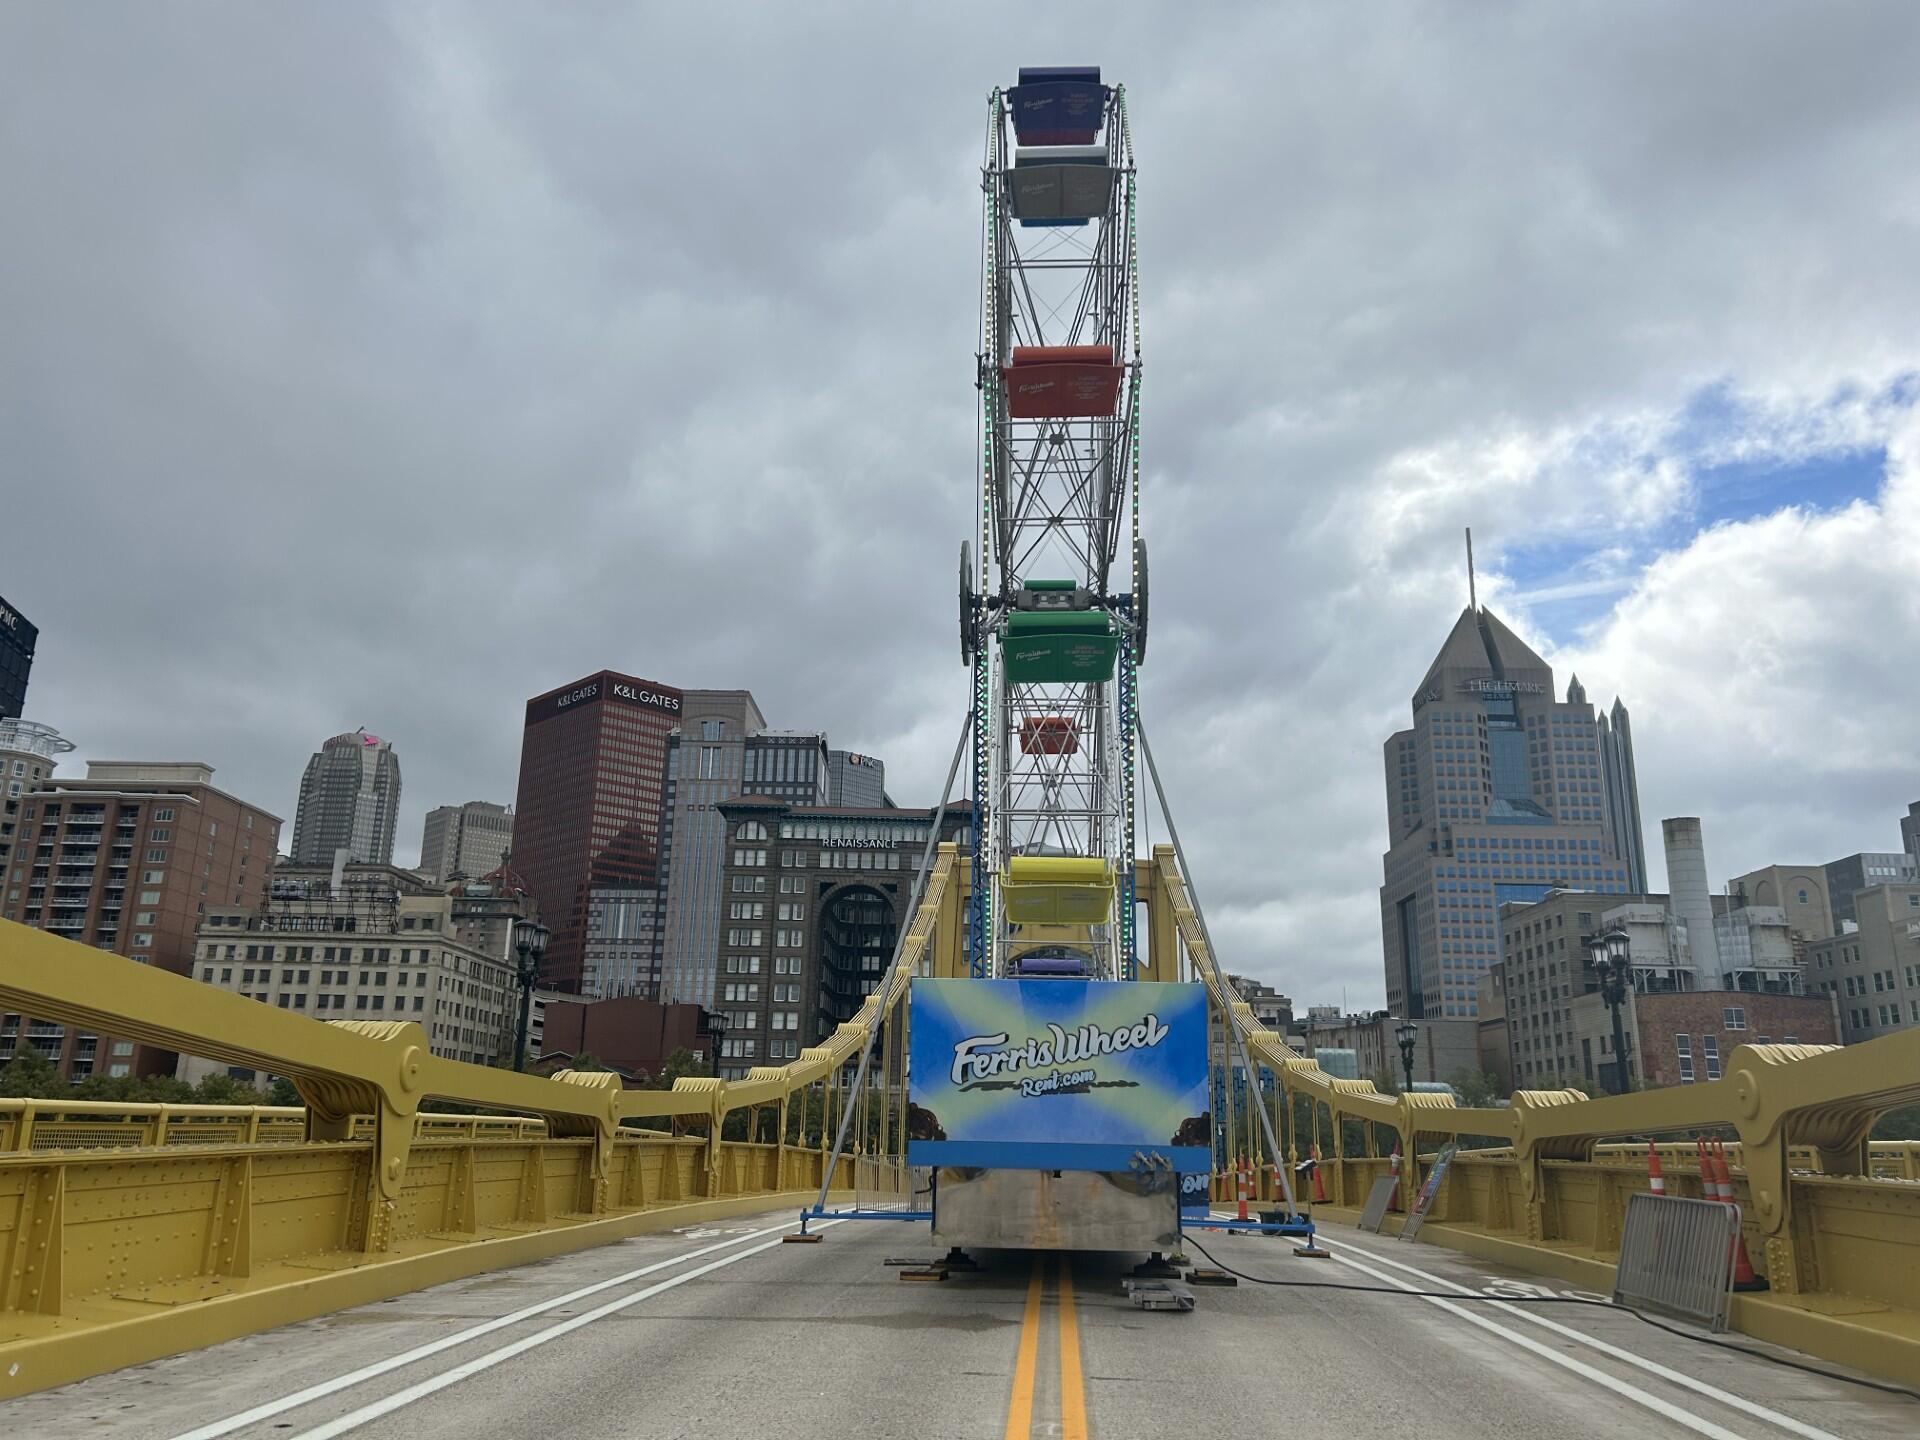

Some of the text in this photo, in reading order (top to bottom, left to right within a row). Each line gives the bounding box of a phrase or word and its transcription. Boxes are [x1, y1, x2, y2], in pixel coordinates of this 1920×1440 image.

[557, 683, 597, 708] K&L GATES
[614, 683, 679, 710] K&L GATES
[822, 838, 898, 849] RENAISSANCE
